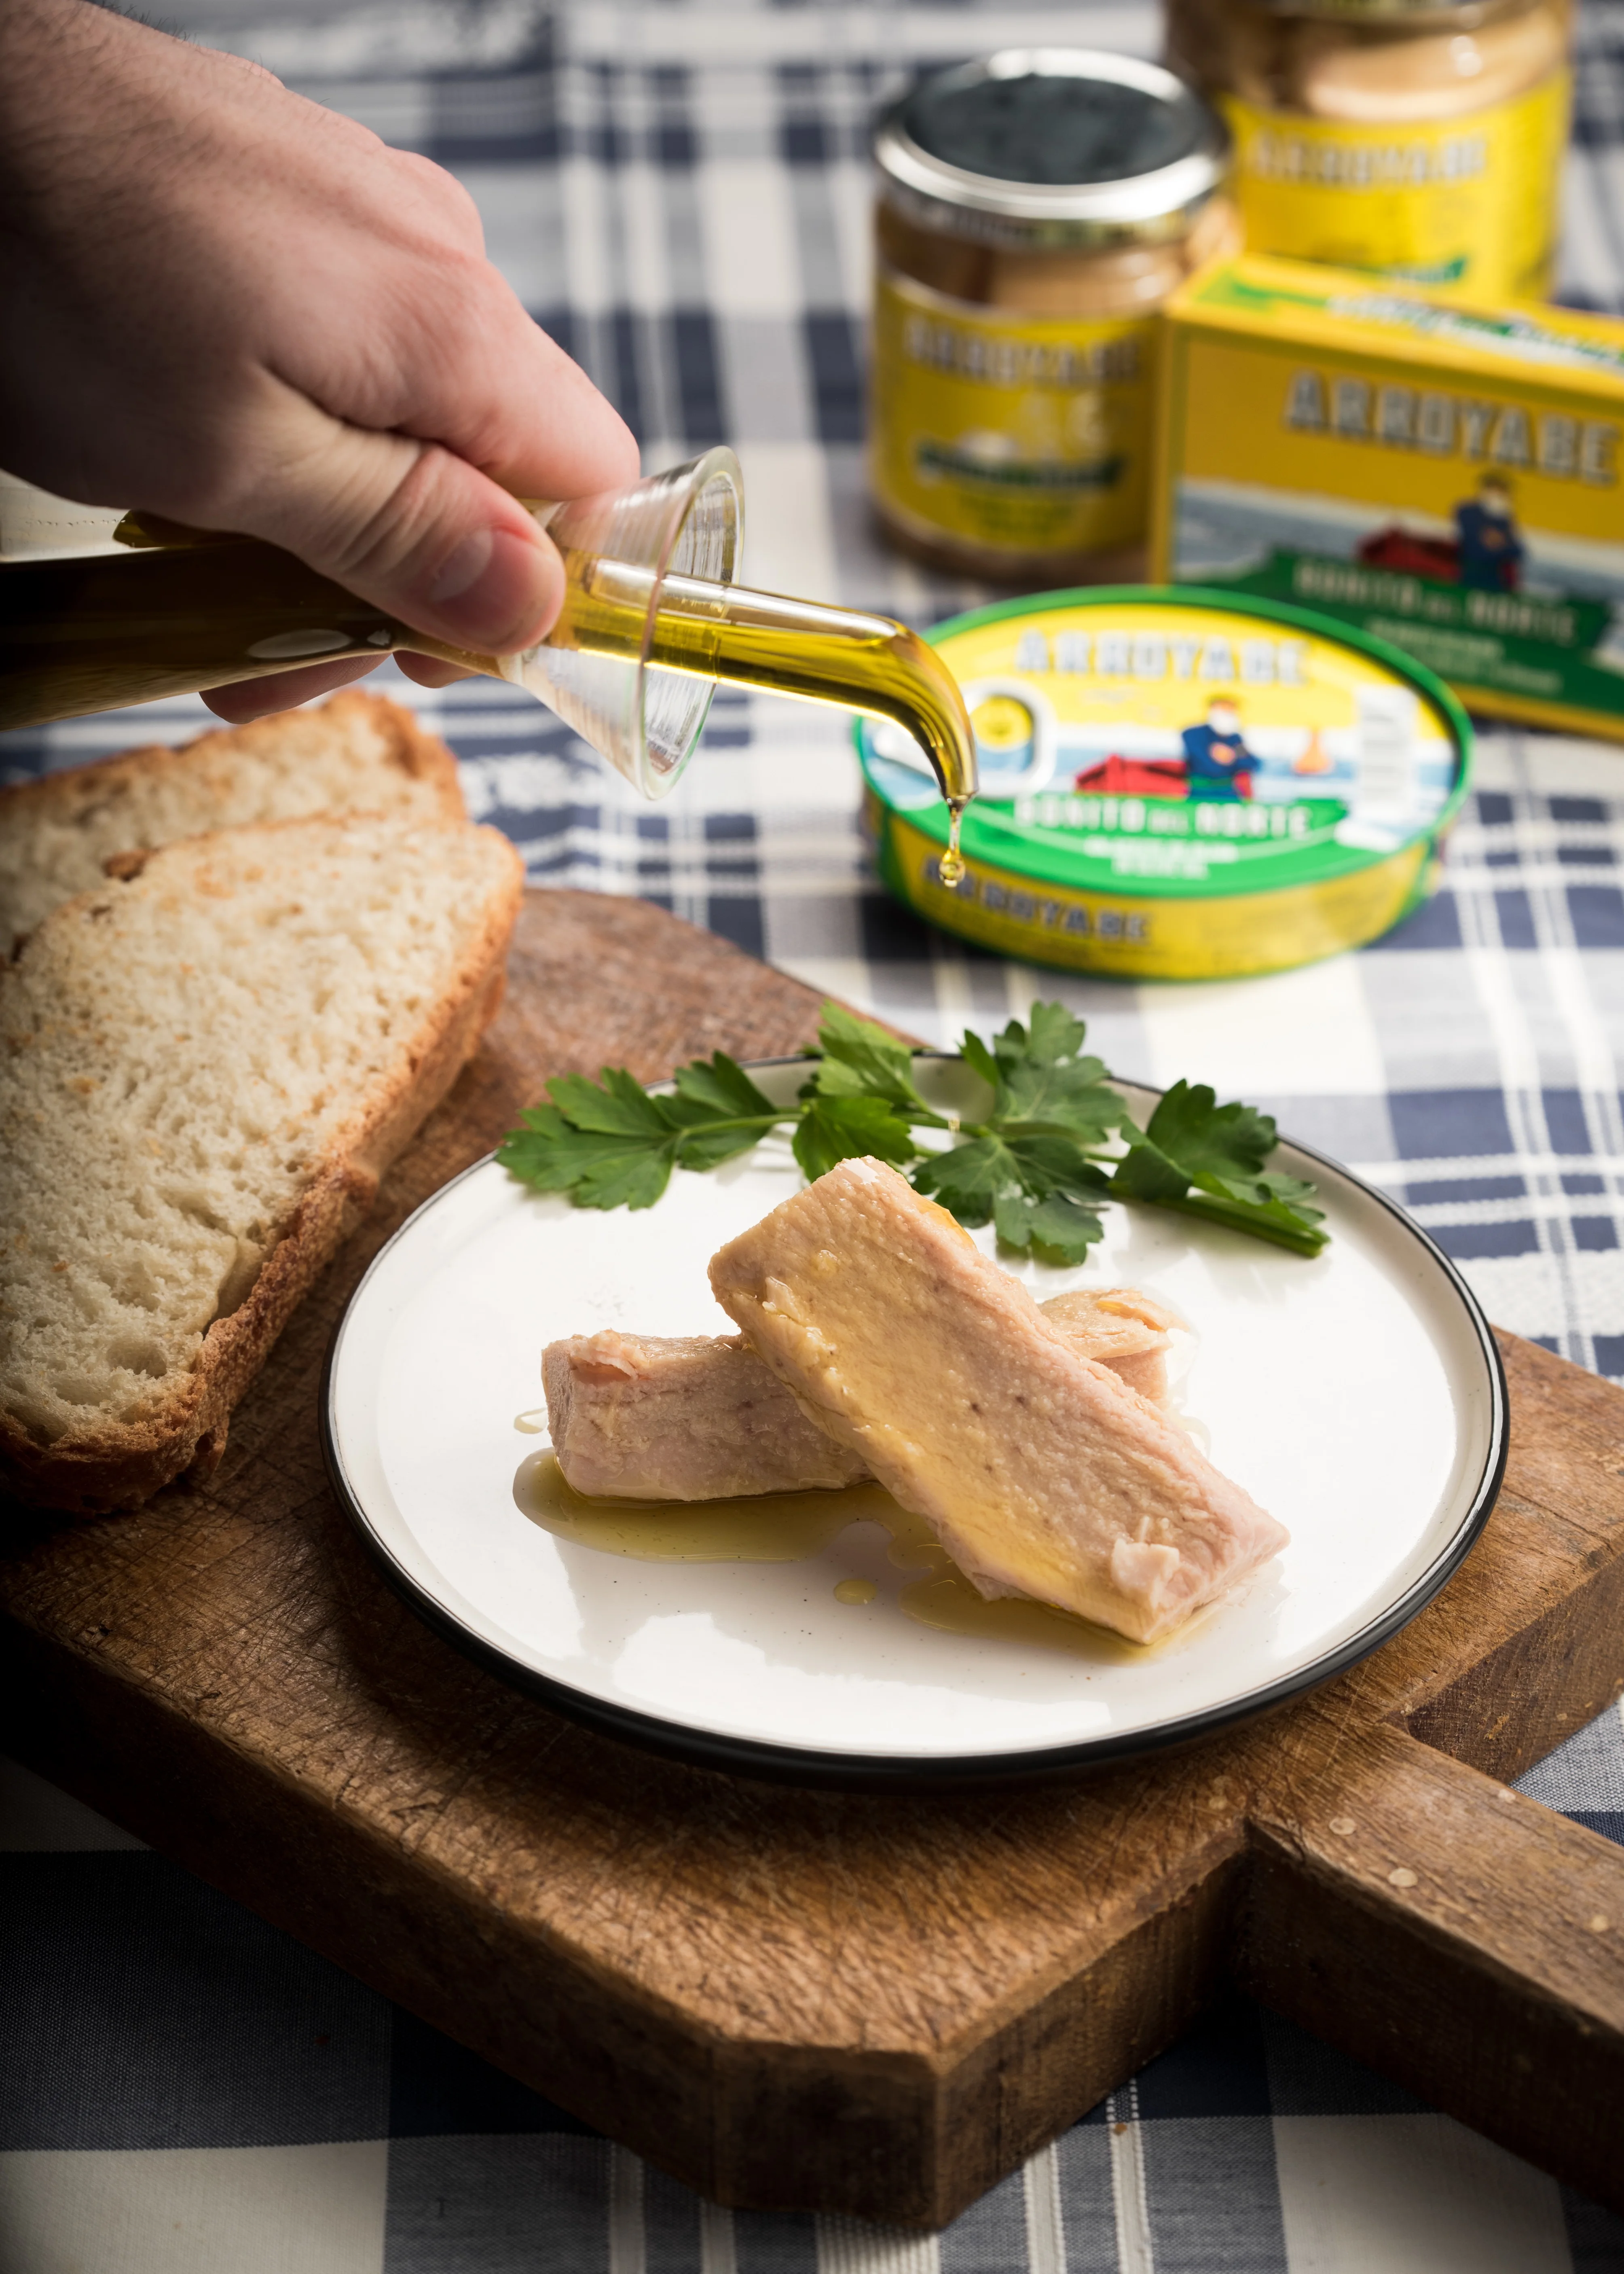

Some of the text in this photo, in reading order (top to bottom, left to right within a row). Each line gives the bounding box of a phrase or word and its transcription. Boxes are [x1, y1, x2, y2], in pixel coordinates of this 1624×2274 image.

[1283, 367, 1621, 487] ARROYABE
[1015, 628, 1309, 686] ARROYABE
[1014, 794, 1146, 832] BONITO
[1195, 802, 1312, 840] NORTE
